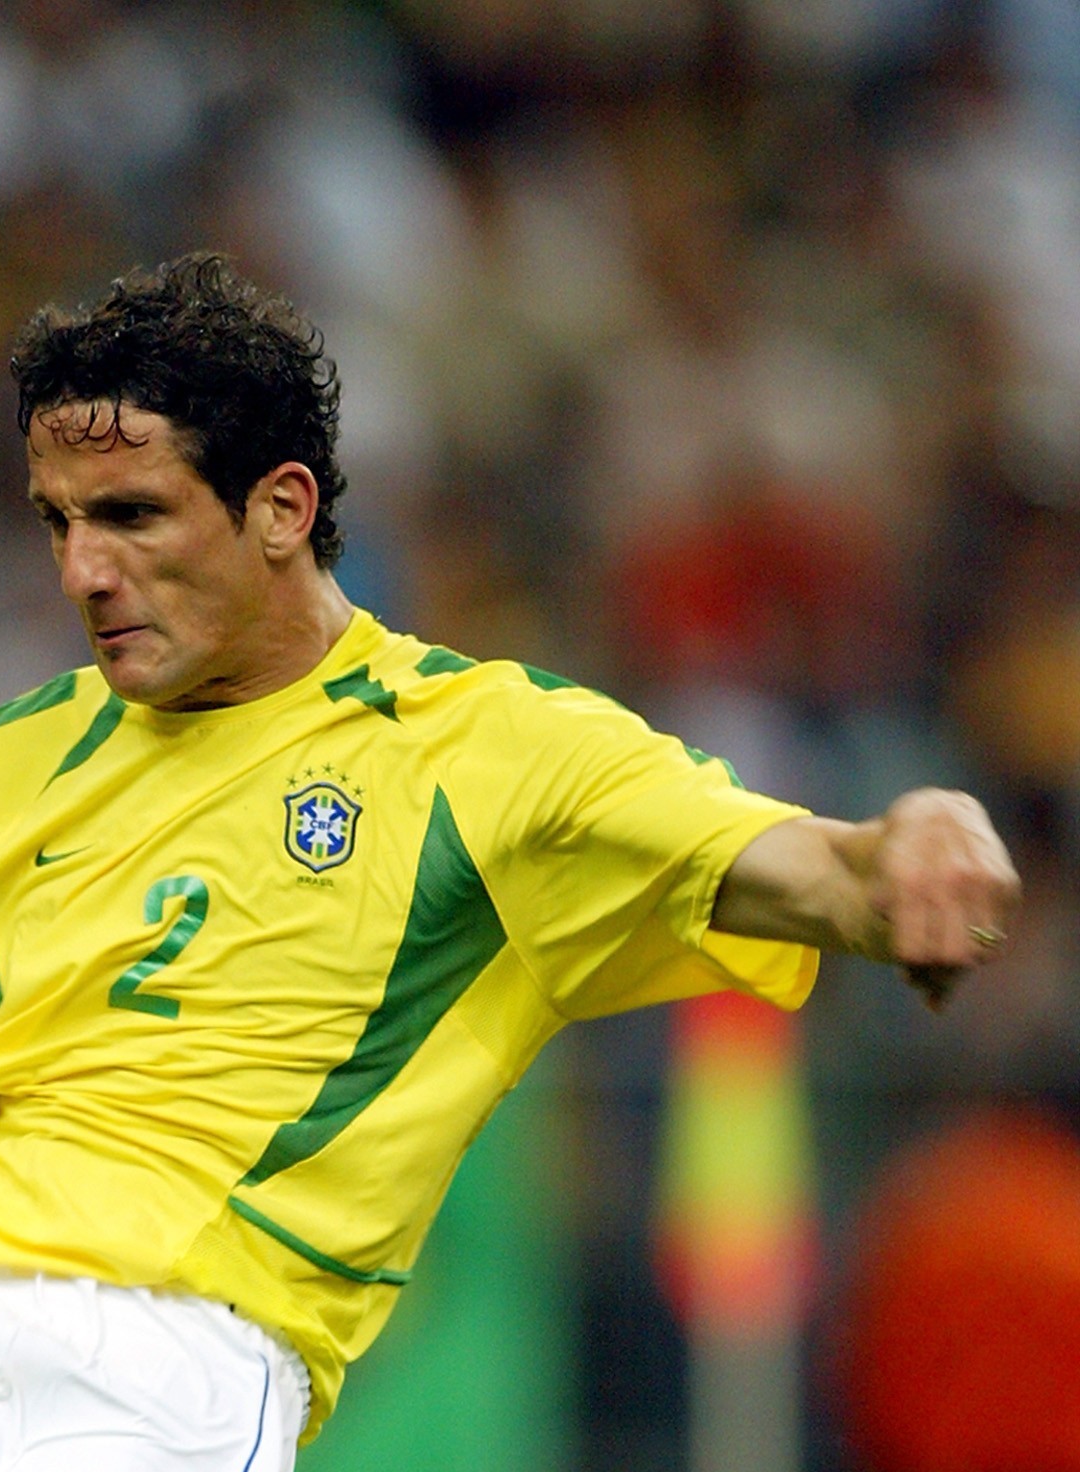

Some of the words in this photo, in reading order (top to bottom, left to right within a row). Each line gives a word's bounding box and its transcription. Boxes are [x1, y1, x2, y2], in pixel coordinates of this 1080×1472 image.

[310, 820, 332, 830] CBF
[297, 876, 334, 887] BRASIL
[108, 875, 210, 1021] 2
